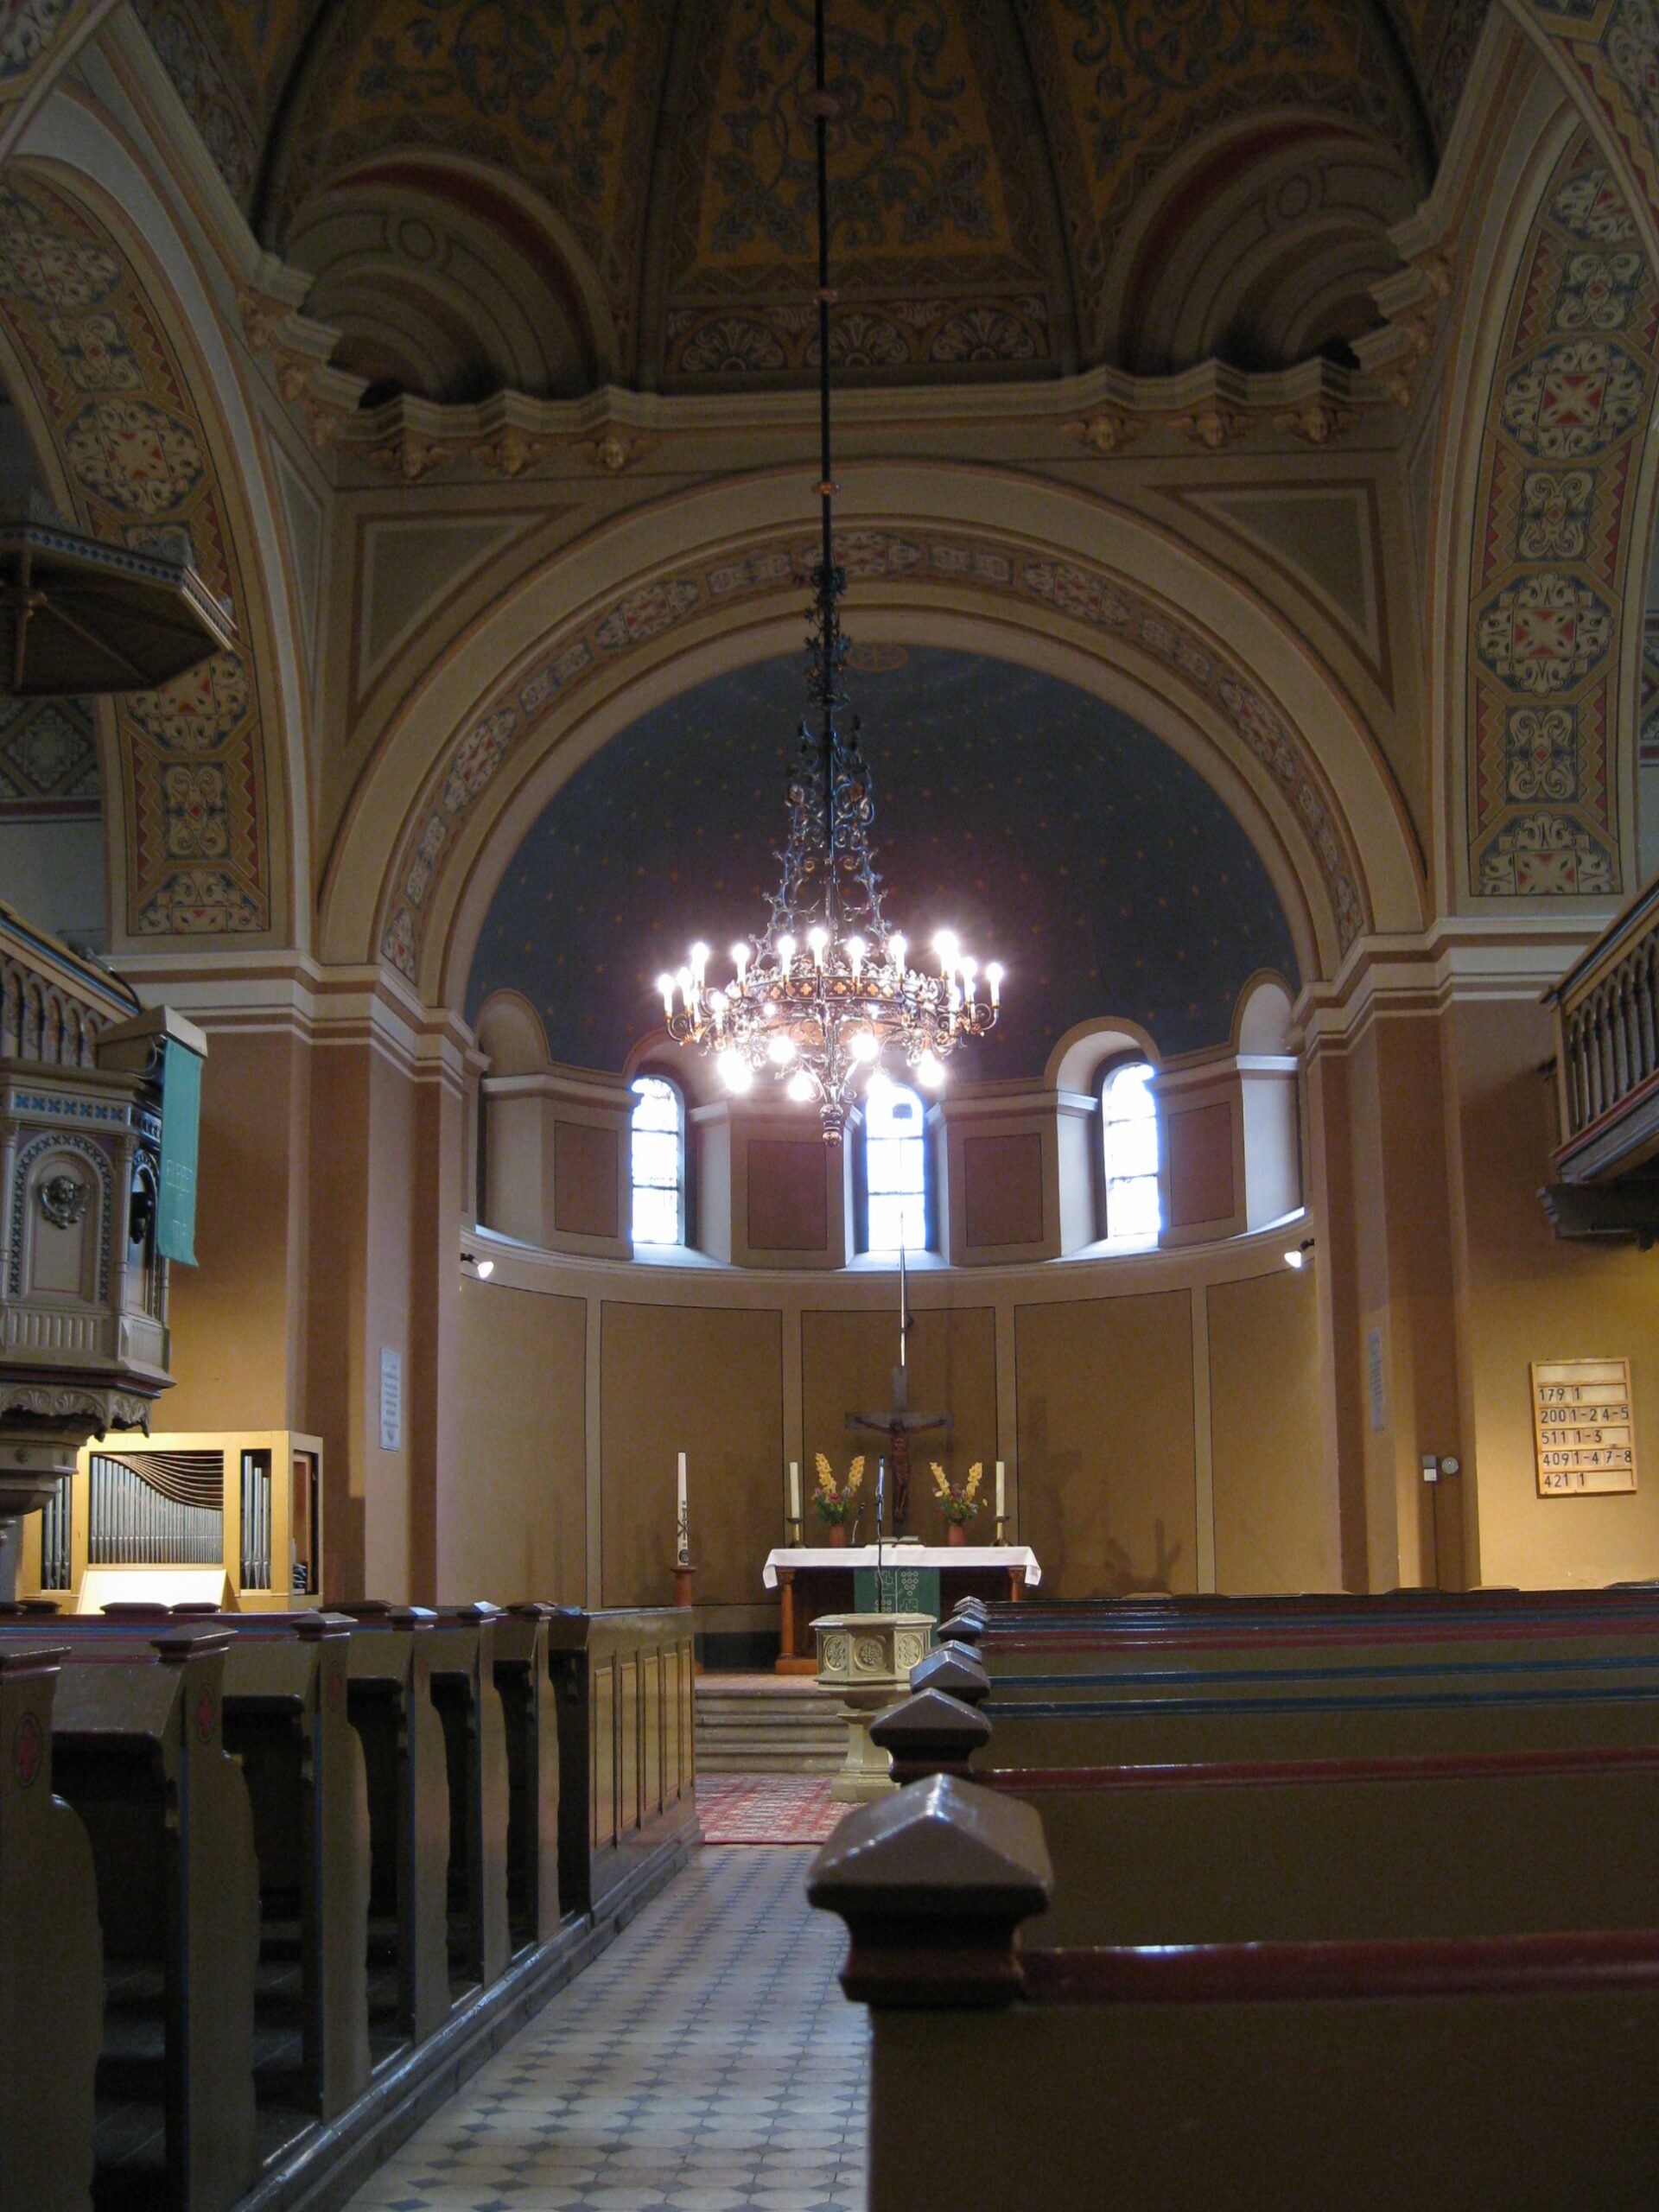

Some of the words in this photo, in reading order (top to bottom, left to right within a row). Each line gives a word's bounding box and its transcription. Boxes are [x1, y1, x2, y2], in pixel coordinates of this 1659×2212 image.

[1539, 1388, 1565, 1402] 179
[1574, 1388, 1580, 1401] 1
[1541, 1409, 1567, 1424] 200
[1541, 1431, 1566, 1445] 511
[1543, 1452, 1569, 1466] 409
[1544, 1473, 1568, 1488] 421
[1580, 1473, 1585, 1486] 1
